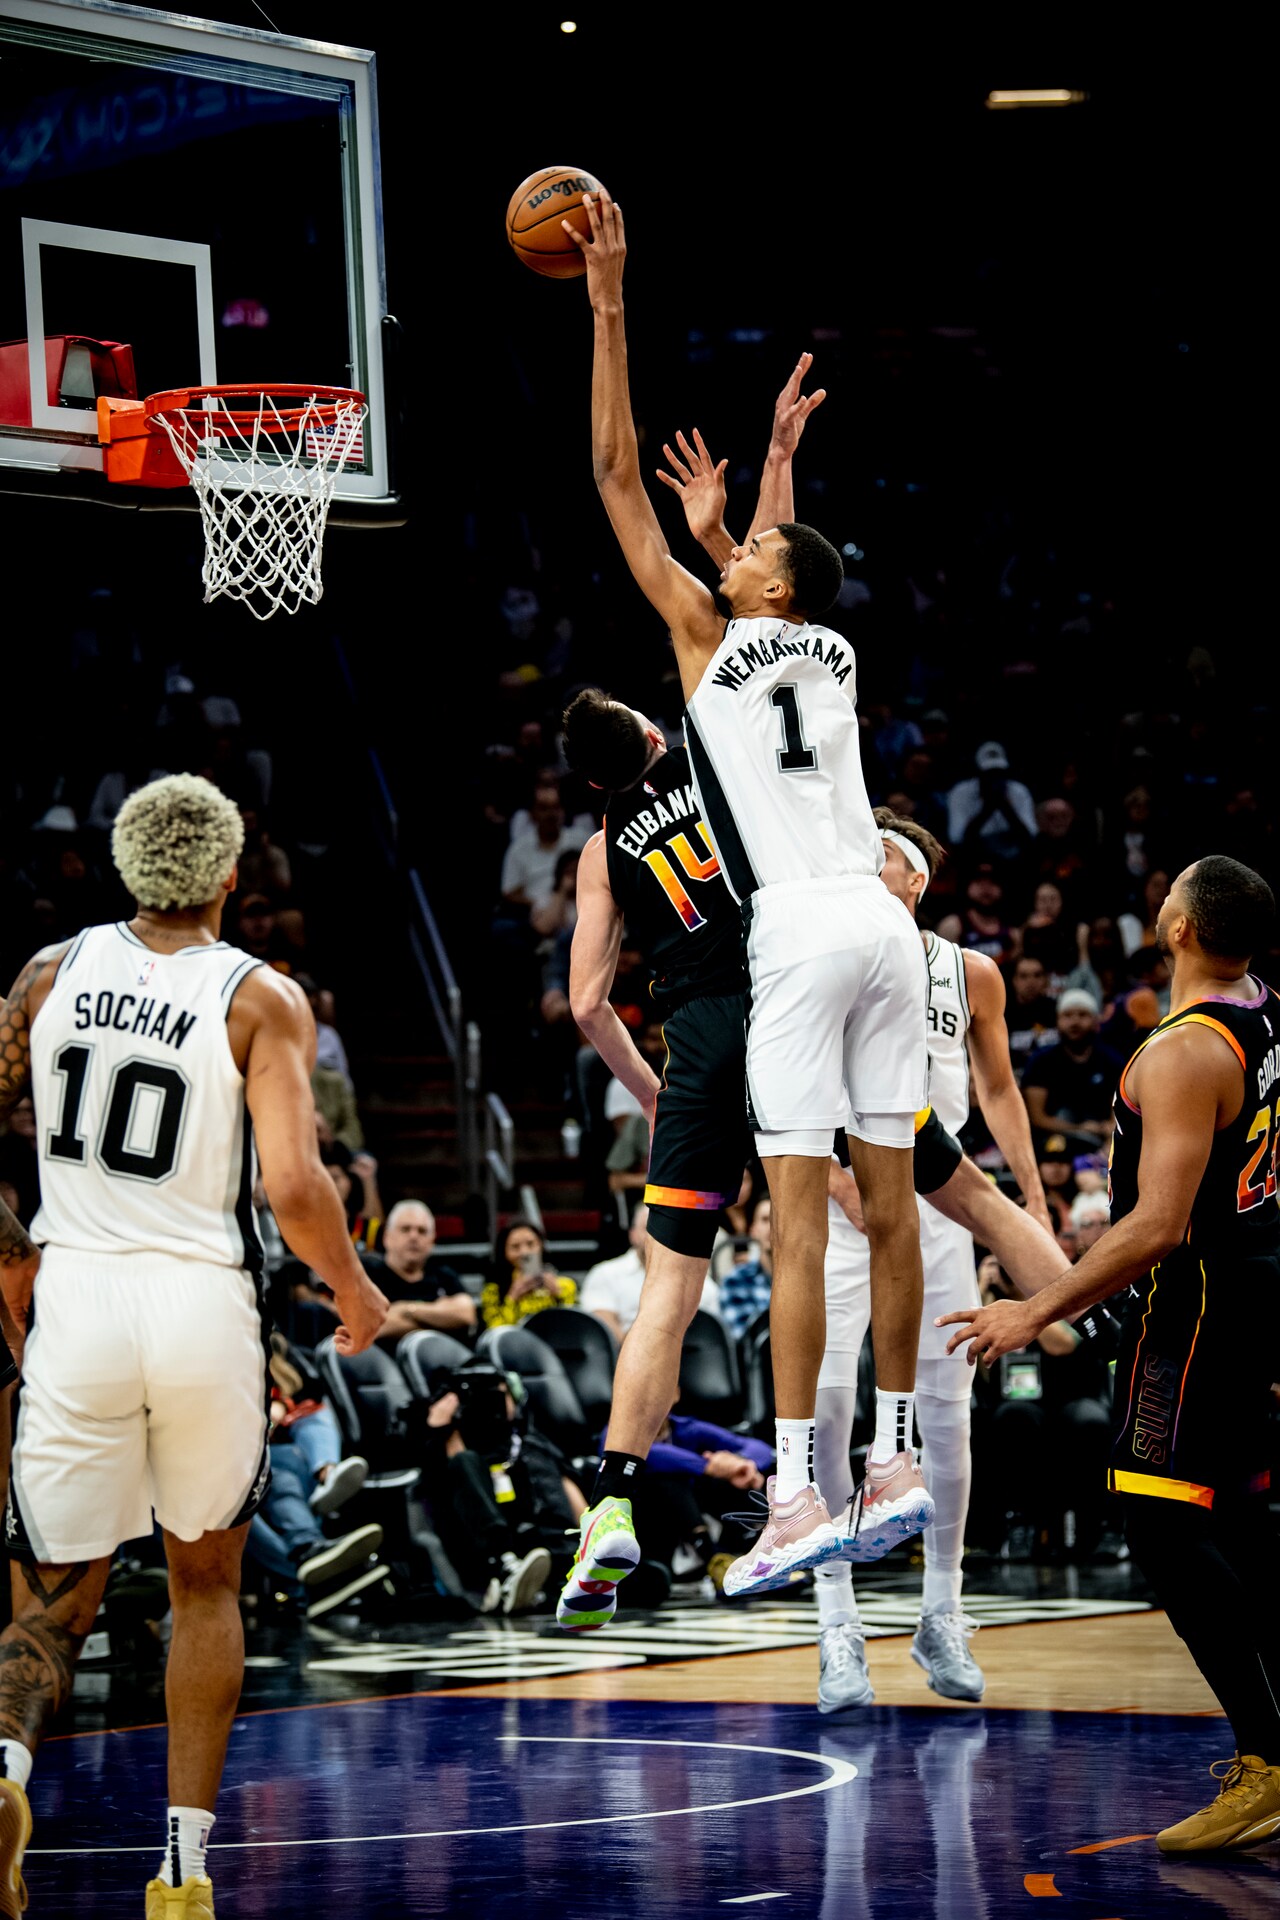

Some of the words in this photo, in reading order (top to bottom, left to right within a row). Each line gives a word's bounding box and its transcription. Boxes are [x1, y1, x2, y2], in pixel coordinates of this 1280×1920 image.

[527, 177, 595, 209] Wilson
[711, 637, 852, 692] WEMBANYAMA
[768, 682, 818, 774] 1
[641, 820, 722, 932] 14
[75, 991, 197, 1050] SOCHAN
[45, 1040, 192, 1186] 10
[1132, 1353, 1178, 1465] SUNS
